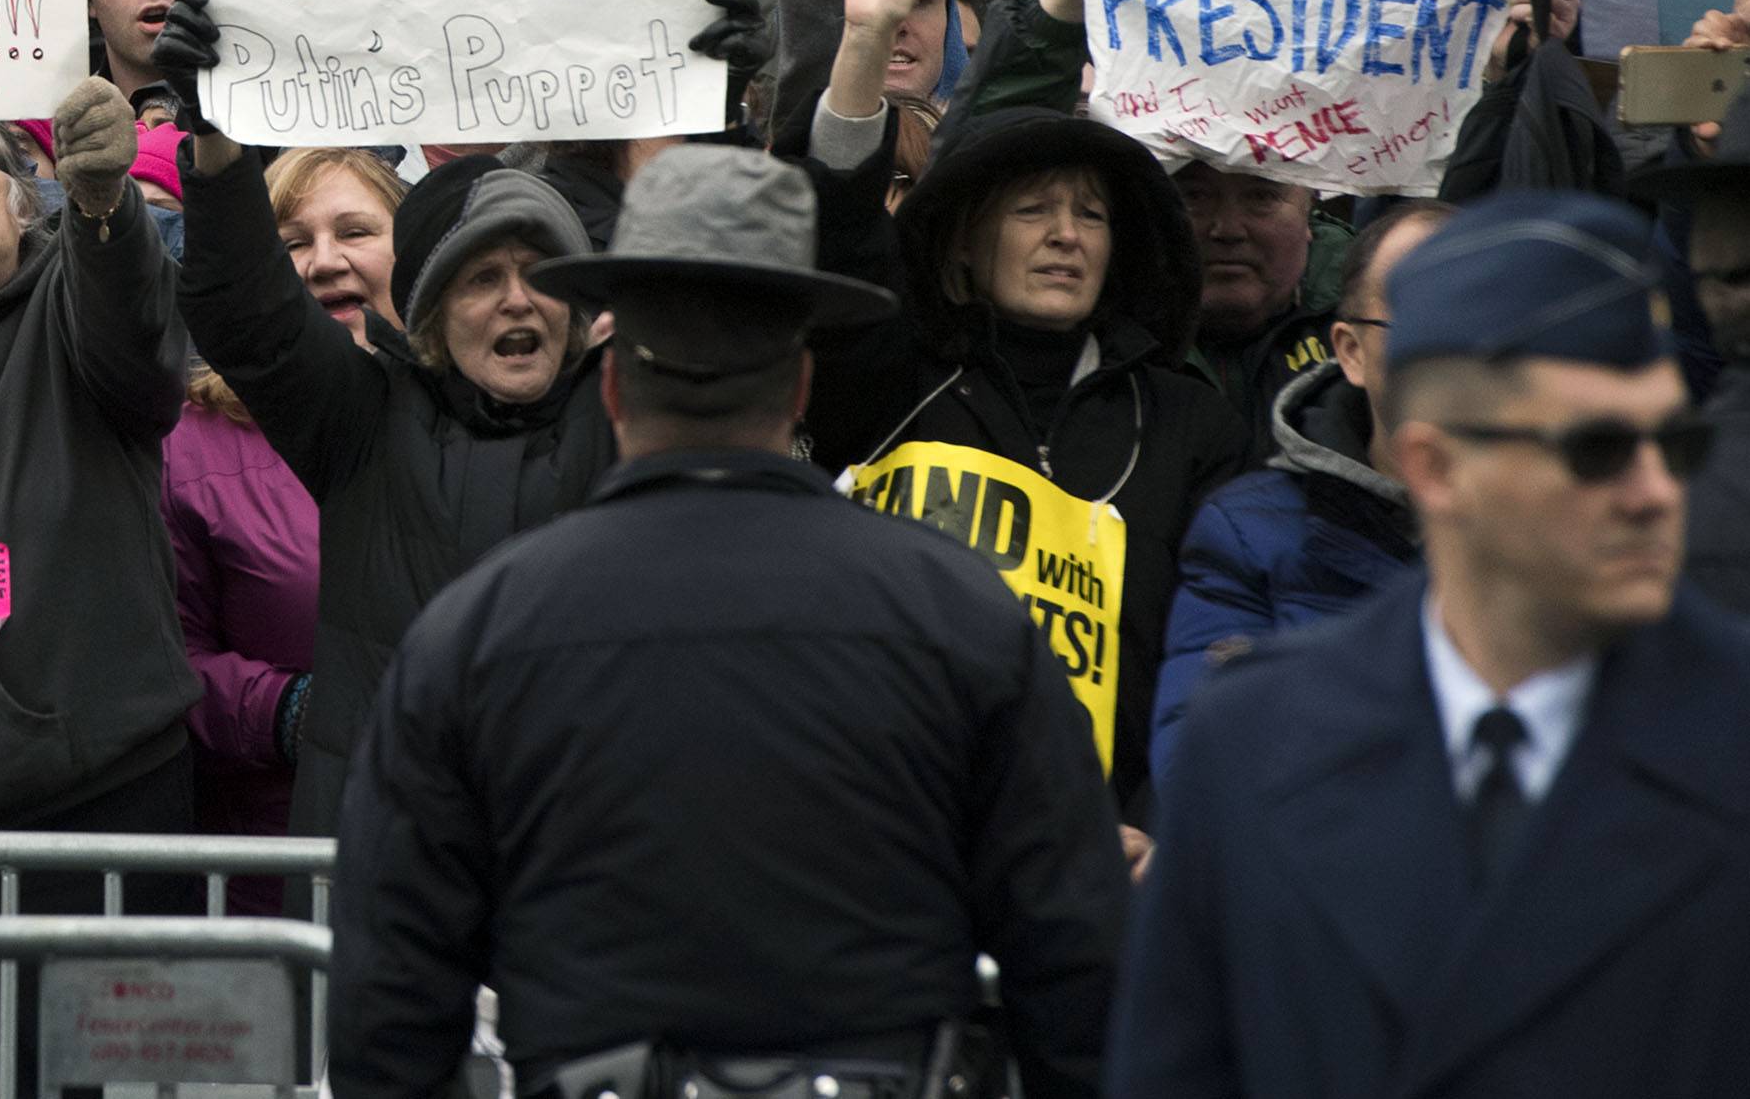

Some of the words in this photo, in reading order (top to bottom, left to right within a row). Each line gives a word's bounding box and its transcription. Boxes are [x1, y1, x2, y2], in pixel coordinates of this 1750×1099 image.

[442, 13, 685, 133] Puppet
[1243, 97, 1370, 165] PENCE
[1036, 547, 1105, 611] with
